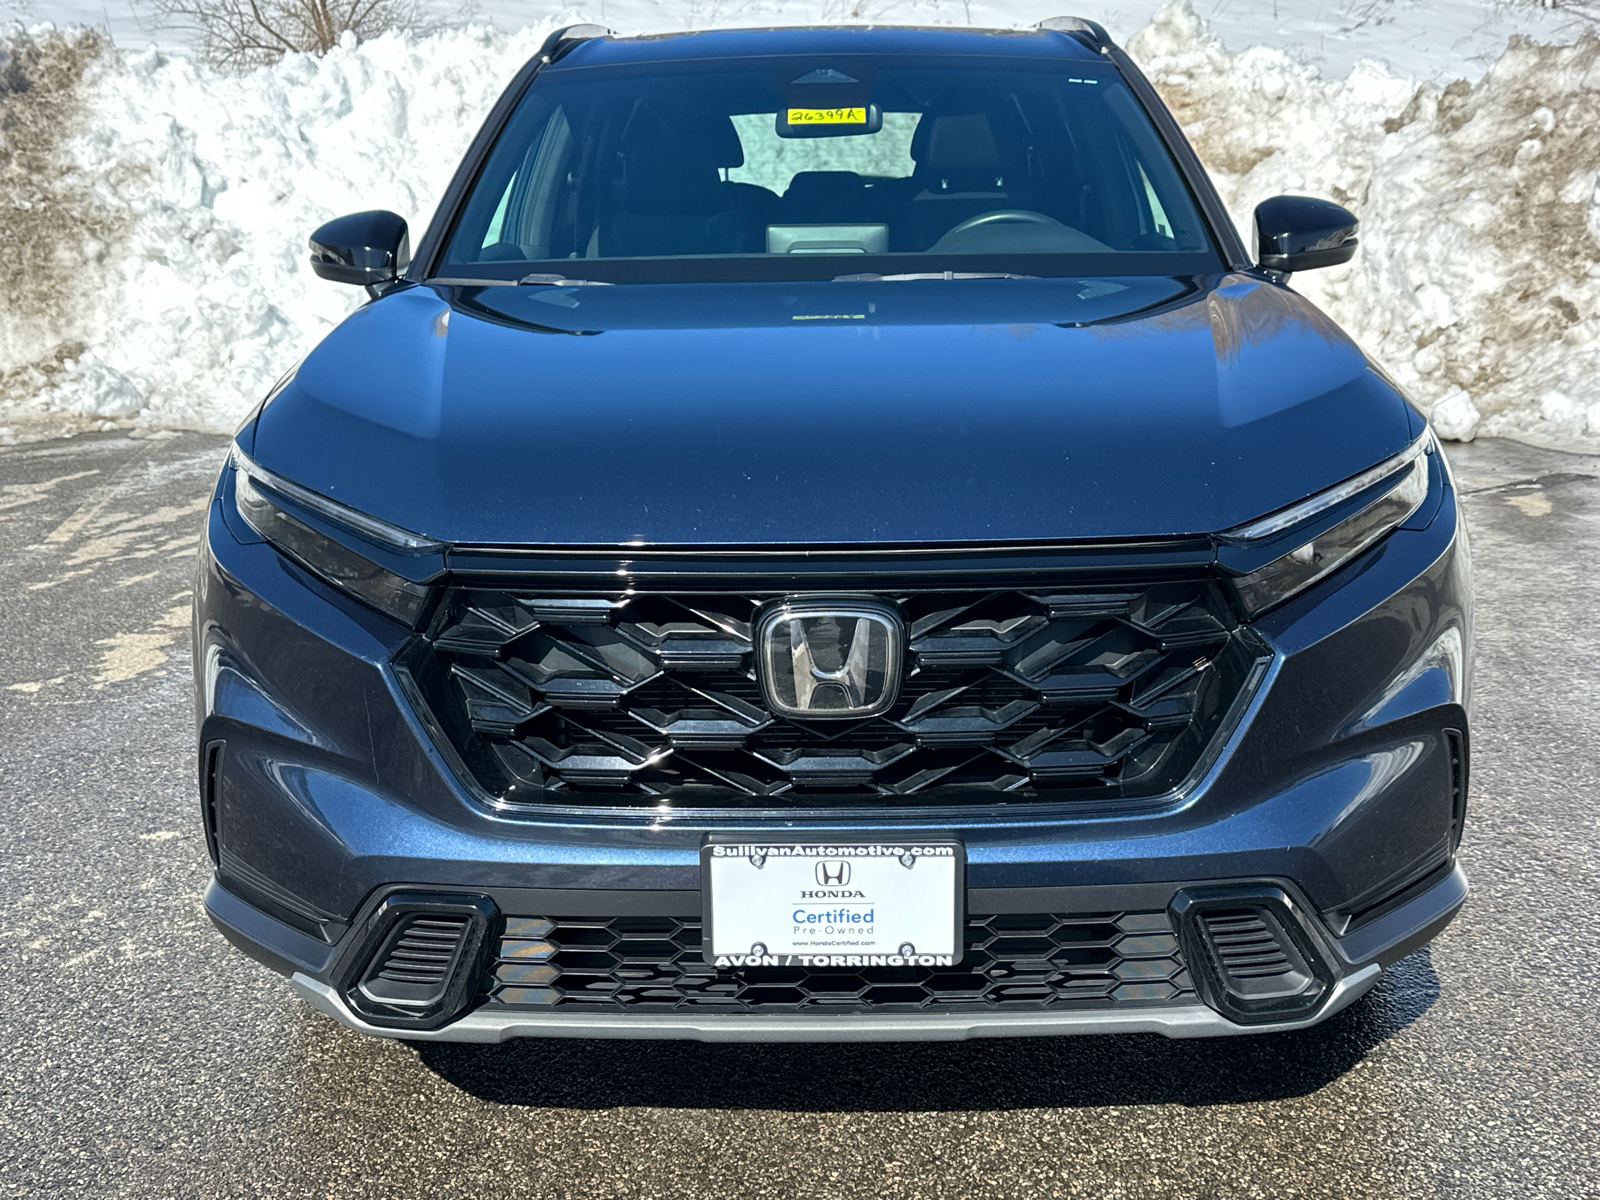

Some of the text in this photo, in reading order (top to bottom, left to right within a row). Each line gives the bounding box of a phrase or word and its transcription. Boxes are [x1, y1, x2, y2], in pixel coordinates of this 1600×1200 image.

[712, 845, 954, 857] SullivanAutomotive.com
[799, 889, 867, 899] HONDA
[792, 908, 875, 924] Certified
[793, 925, 875, 935] Pre-Owned
[714, 955, 779, 967] AVON
[797, 954, 953, 967] TORRINGTON
